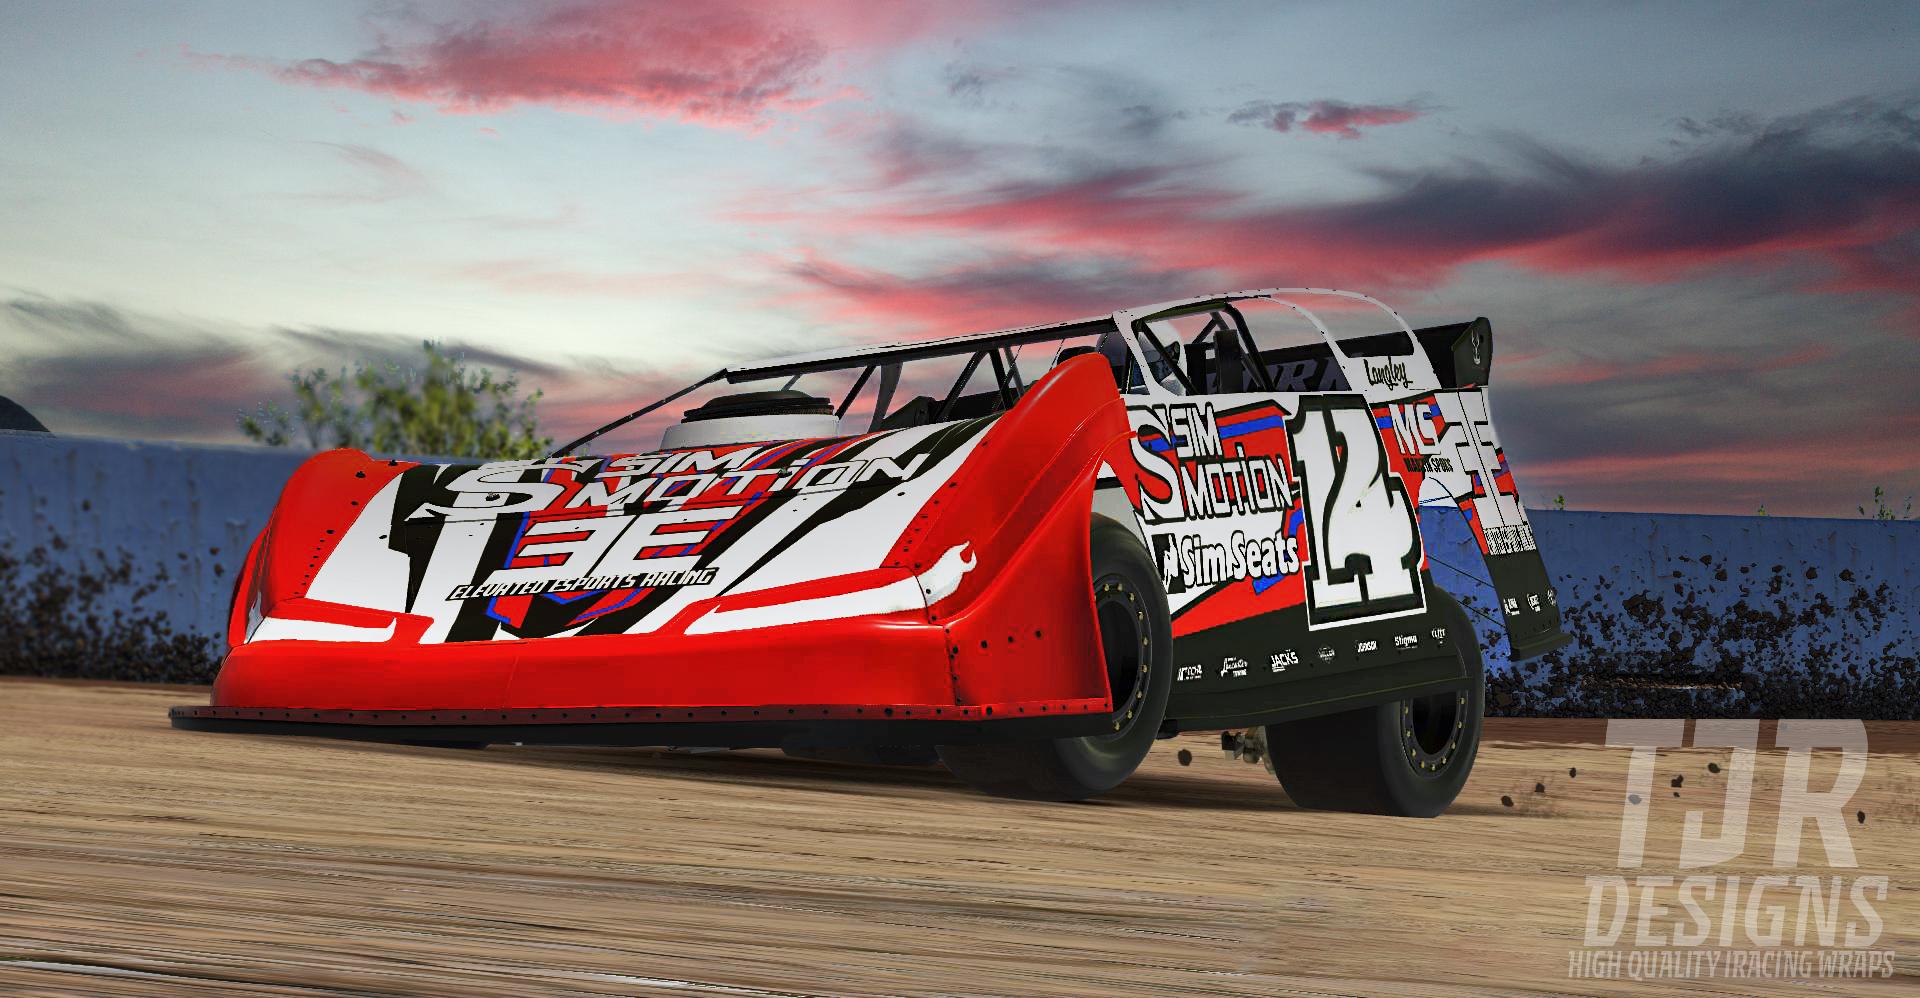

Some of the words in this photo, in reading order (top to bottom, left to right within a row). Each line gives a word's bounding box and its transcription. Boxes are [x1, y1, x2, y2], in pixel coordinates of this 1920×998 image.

[1363, 356, 1413, 391] Langley
[1169, 403, 1224, 459] SIM
[565, 453, 931, 511] MOTION
[594, 446, 764, 479] SIM
[1179, 443, 1293, 519] MOTION
[449, 580, 546, 599] ELEVATED
[550, 574, 638, 592] ESPORTS
[640, 567, 714, 587] RACING
